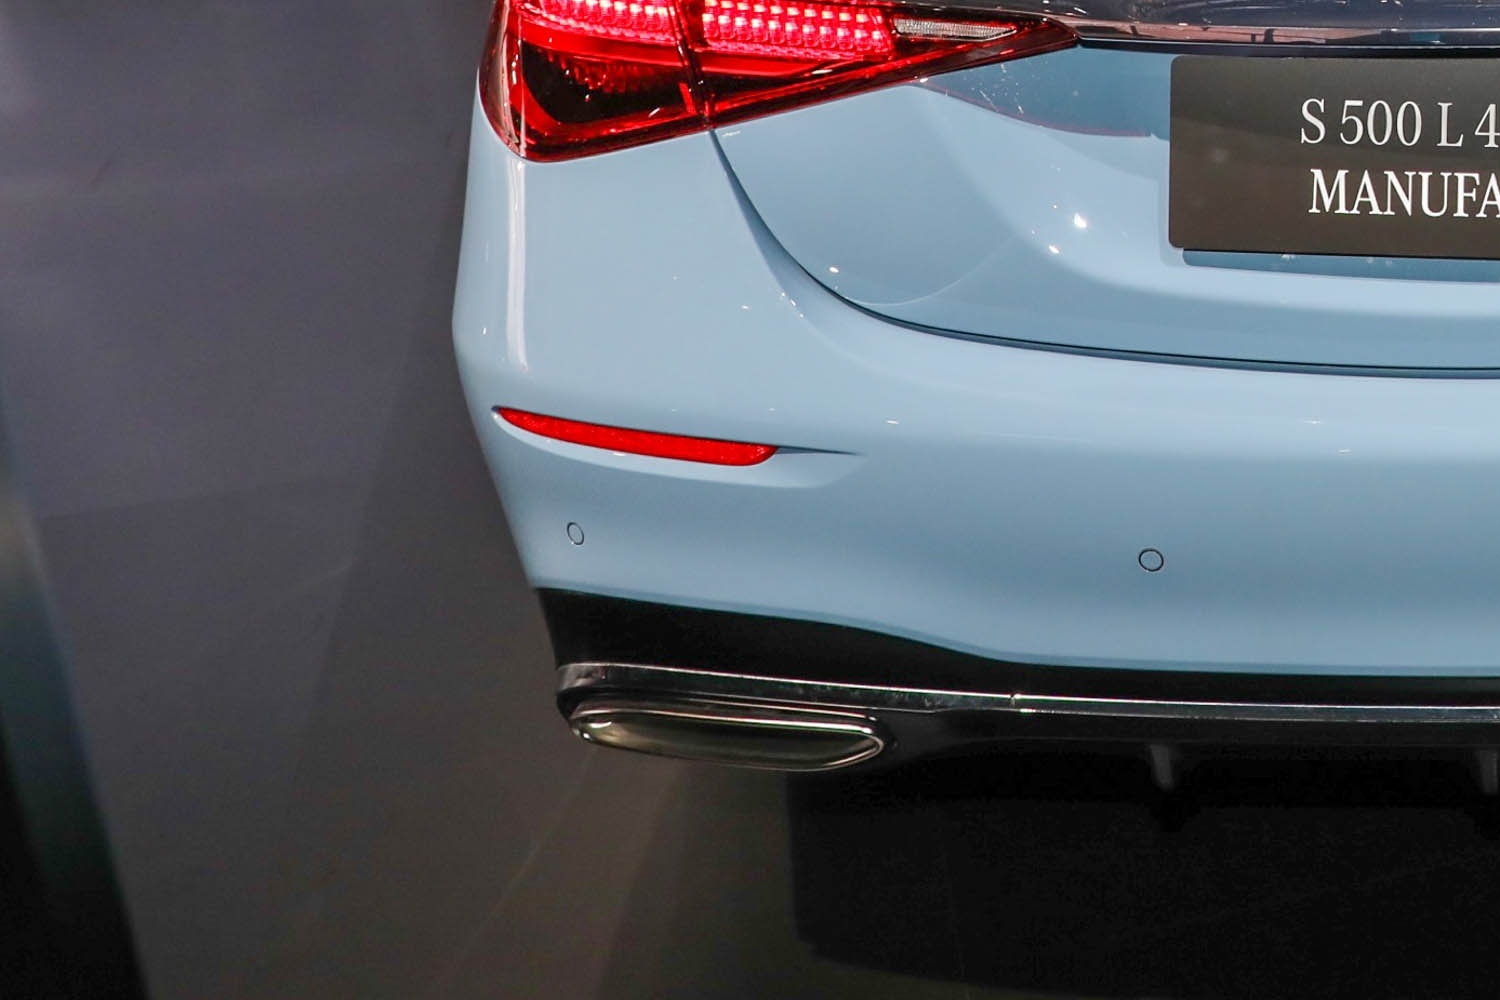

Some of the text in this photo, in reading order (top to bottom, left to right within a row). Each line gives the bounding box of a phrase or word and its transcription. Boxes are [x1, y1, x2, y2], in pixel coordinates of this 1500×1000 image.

[1300, 98, 1326, 144] S
[1339, 100, 1422, 146] 500
[1436, 102, 1464, 147] L
